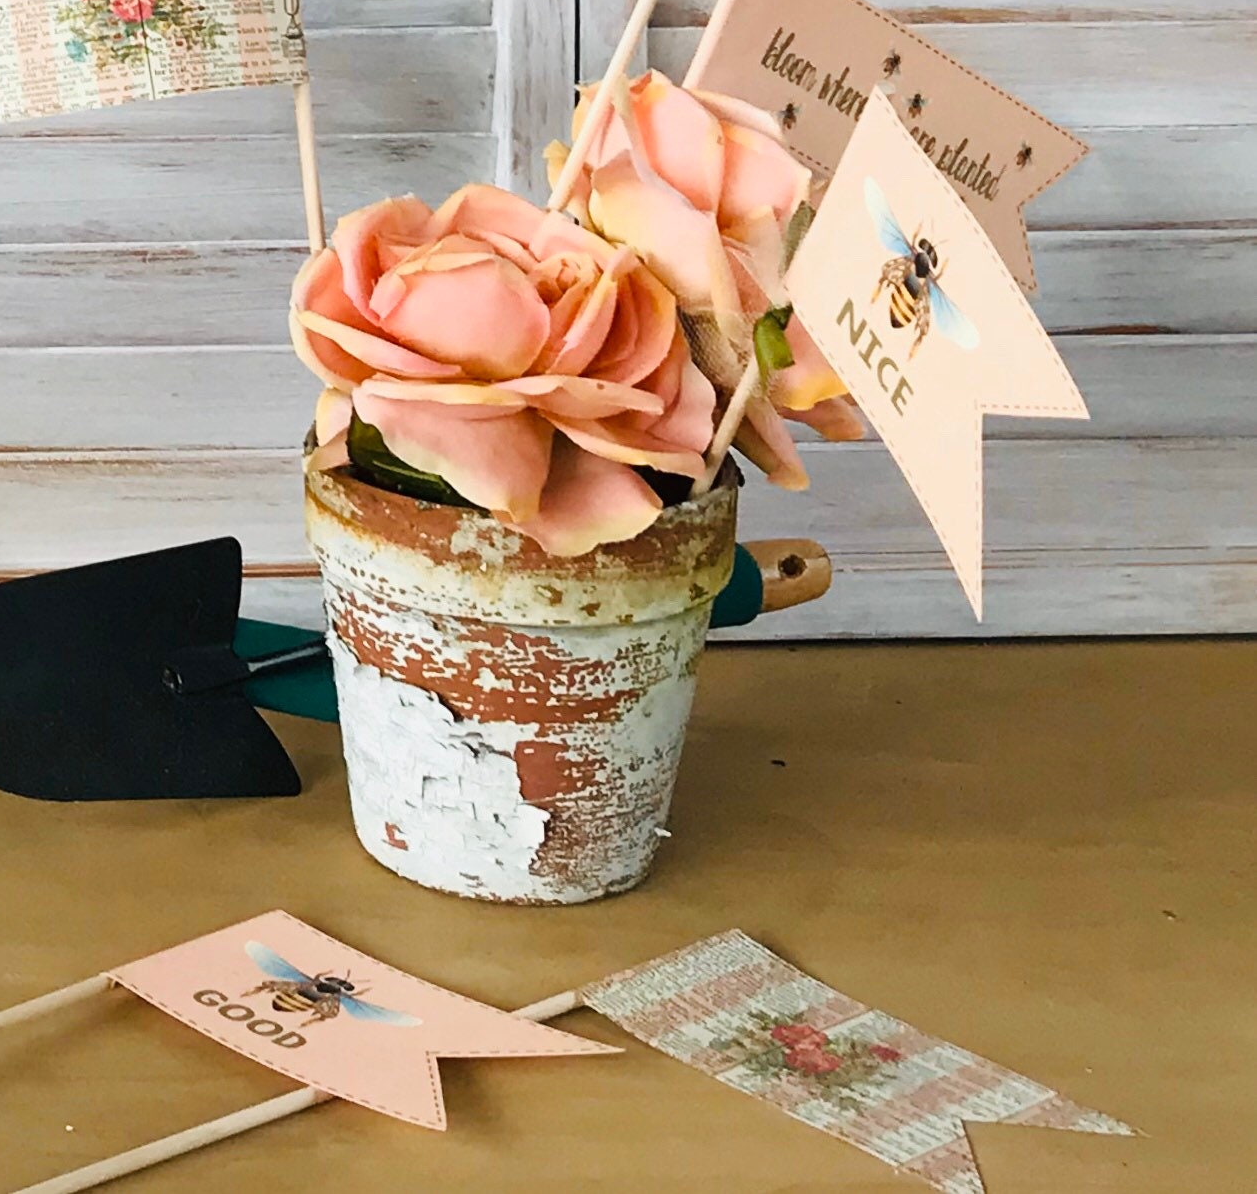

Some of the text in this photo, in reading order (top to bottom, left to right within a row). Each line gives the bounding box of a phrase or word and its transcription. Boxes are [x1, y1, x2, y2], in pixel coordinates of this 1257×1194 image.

[760, 26, 818, 93] bloom
[935, 137, 1008, 202] planted
[836, 297, 915, 417] NICE
[192, 988, 308, 1050] GOOD
